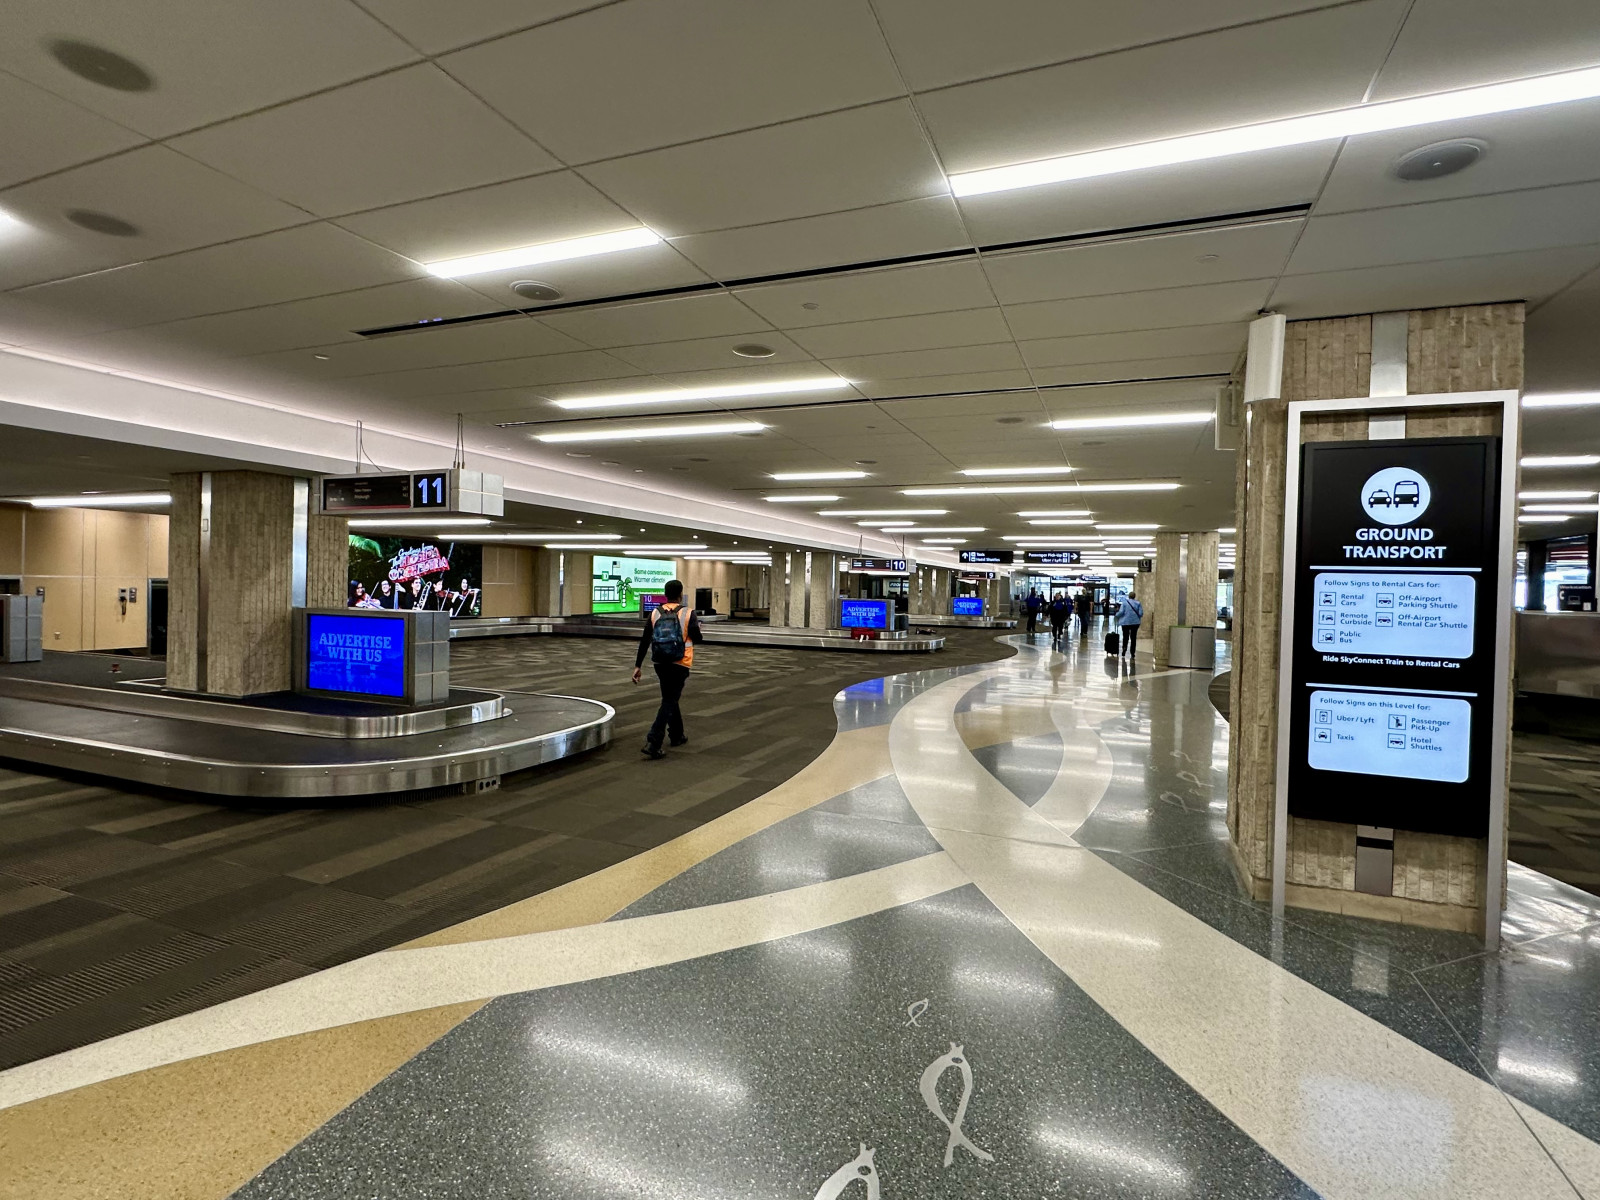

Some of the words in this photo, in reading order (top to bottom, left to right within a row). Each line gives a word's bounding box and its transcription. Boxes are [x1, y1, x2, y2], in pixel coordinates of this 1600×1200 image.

[418, 478, 442, 504] 11
[1356, 528, 1433, 540] GROUND
[1343, 546, 1446, 558] TRANSPORT
[894, 561, 905, 570] 10
[319, 633, 391, 649] ADVERTISE
[328, 647, 362, 661] WITH
[365, 650, 382, 662] US
[1411, 718, 1450, 726] Passenger
